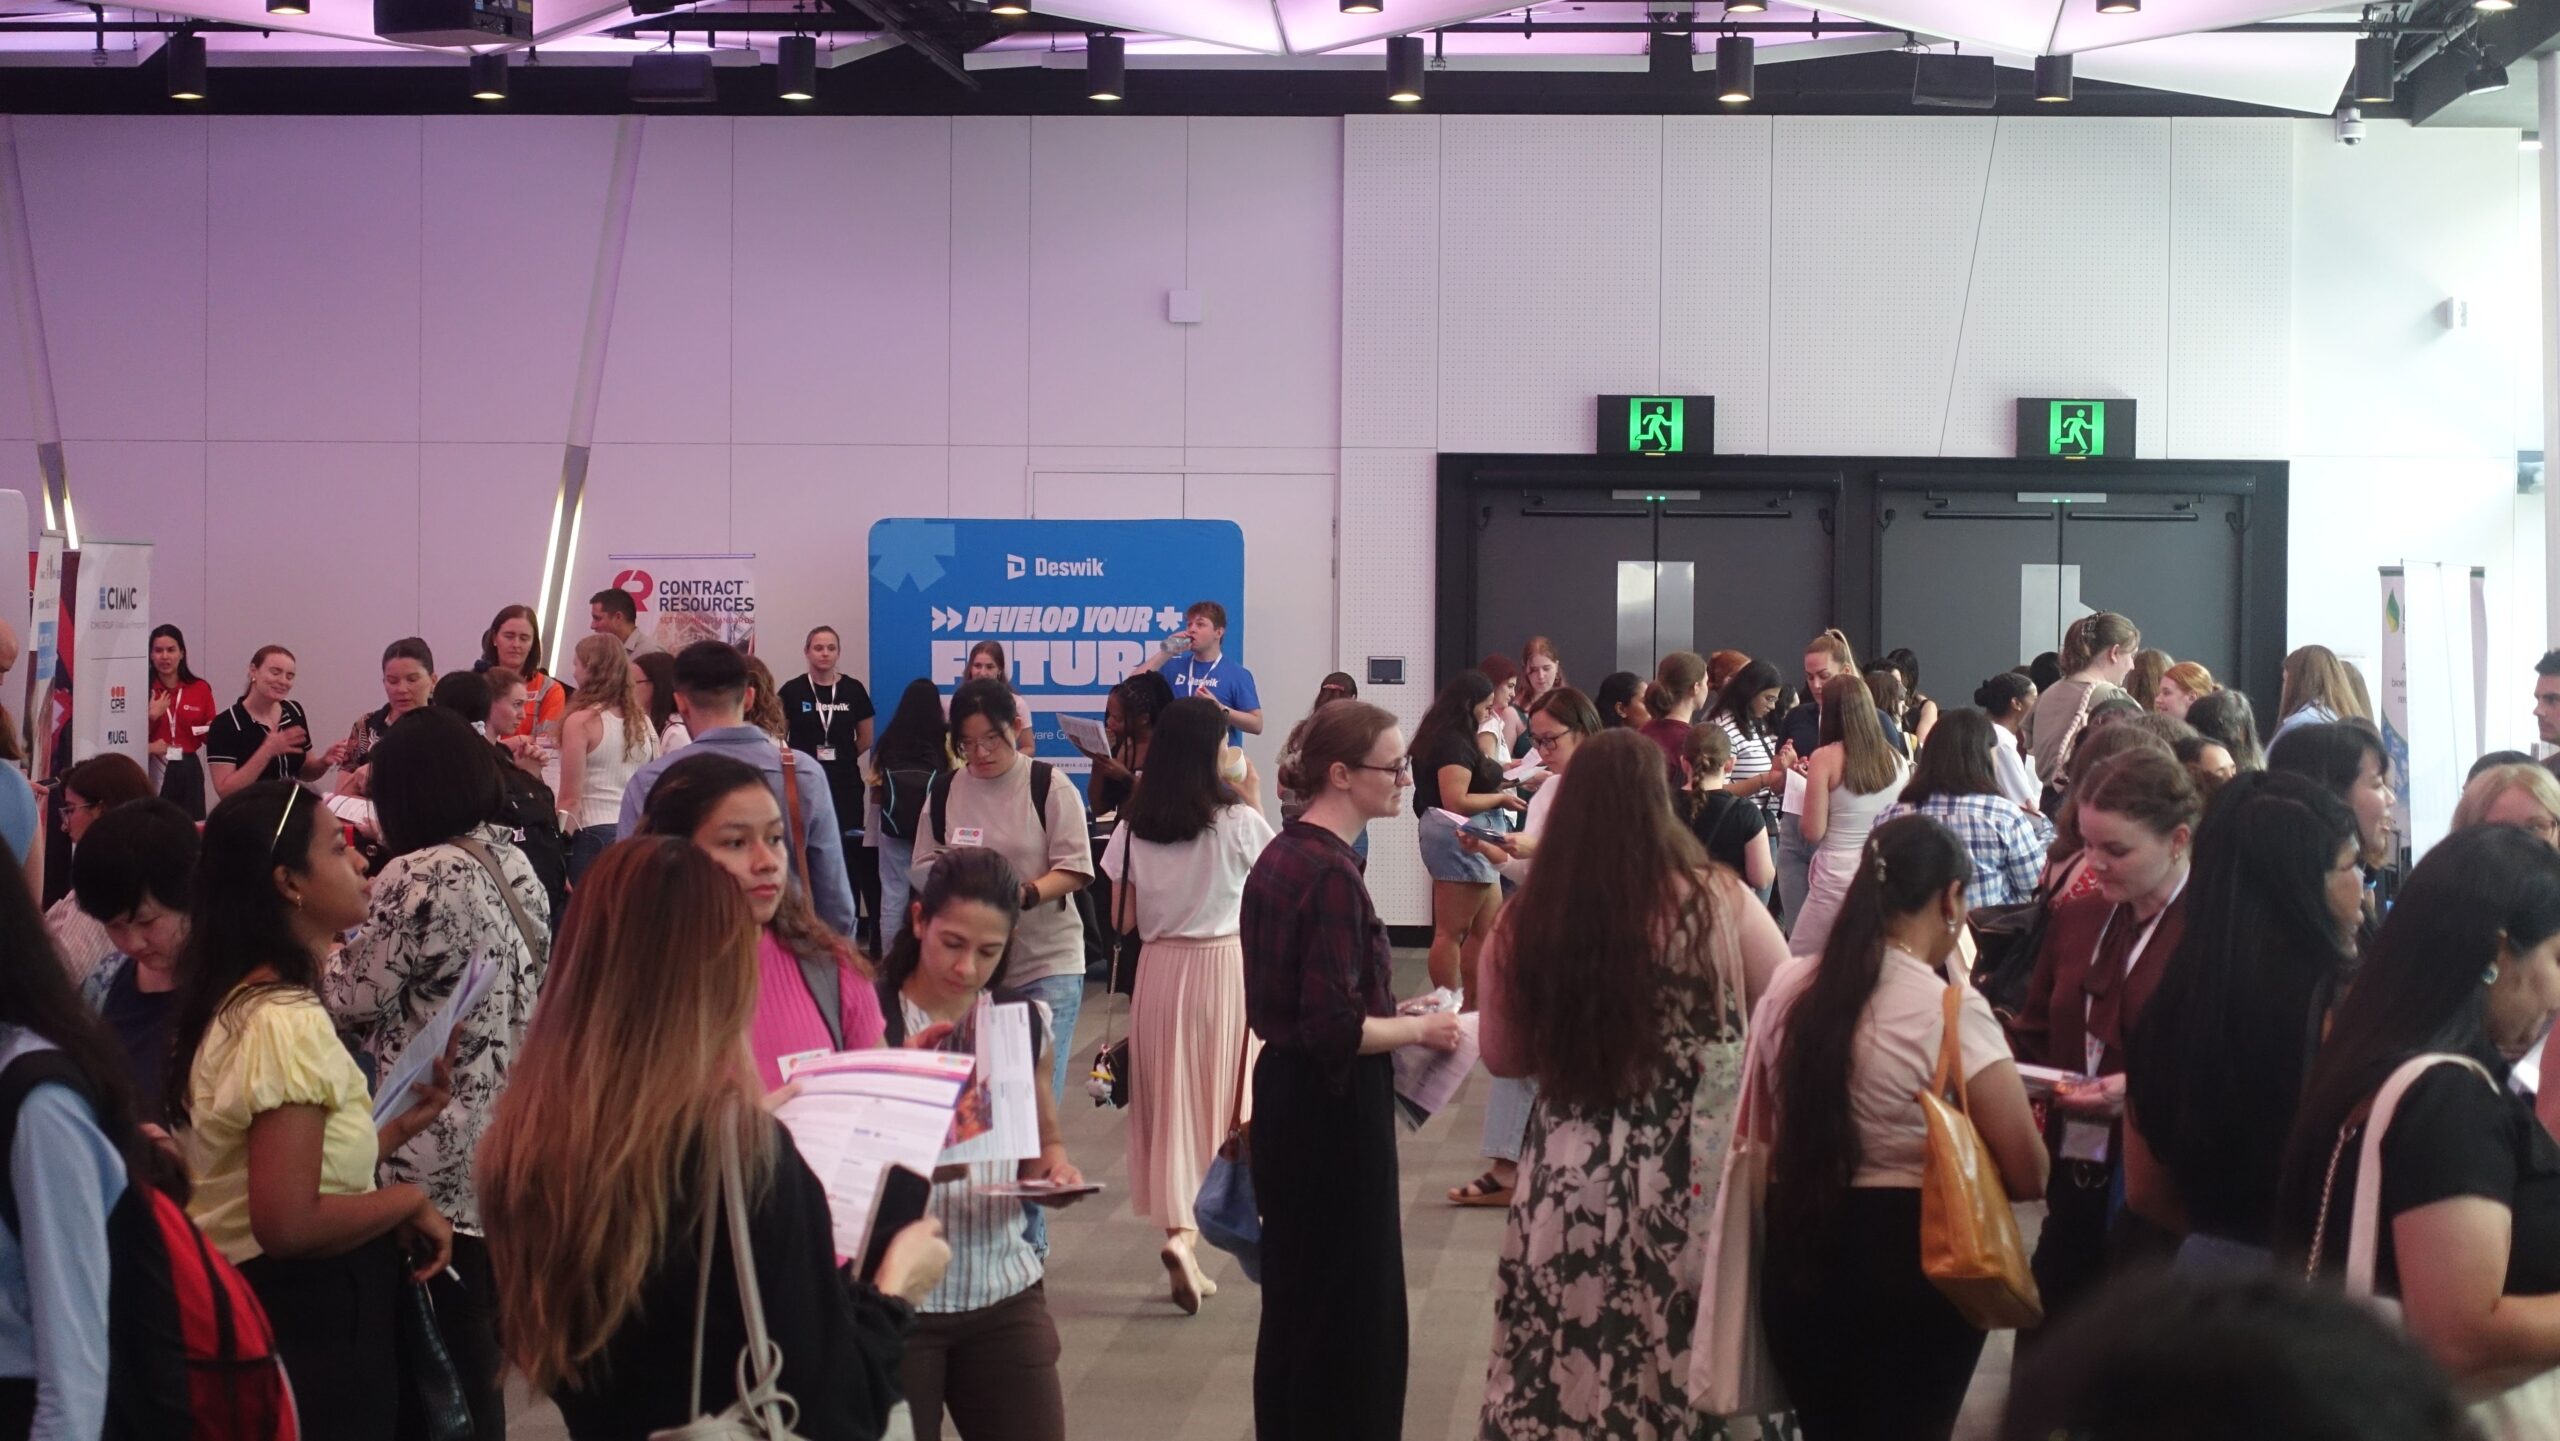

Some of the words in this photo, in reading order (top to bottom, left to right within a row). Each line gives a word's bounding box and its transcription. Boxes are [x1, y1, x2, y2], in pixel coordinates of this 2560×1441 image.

[1035, 557, 1104, 577] Deswik
[659, 580, 744, 596] CONTRACT
[107, 587, 137, 610] CIMIC
[659, 597, 755, 612] RESOURCES
[964, 606, 1080, 633] DEVELOP
[1082, 606, 1154, 633] YOUR
[111, 698, 126, 710] CPB
[112, 730, 129, 744] UGL
